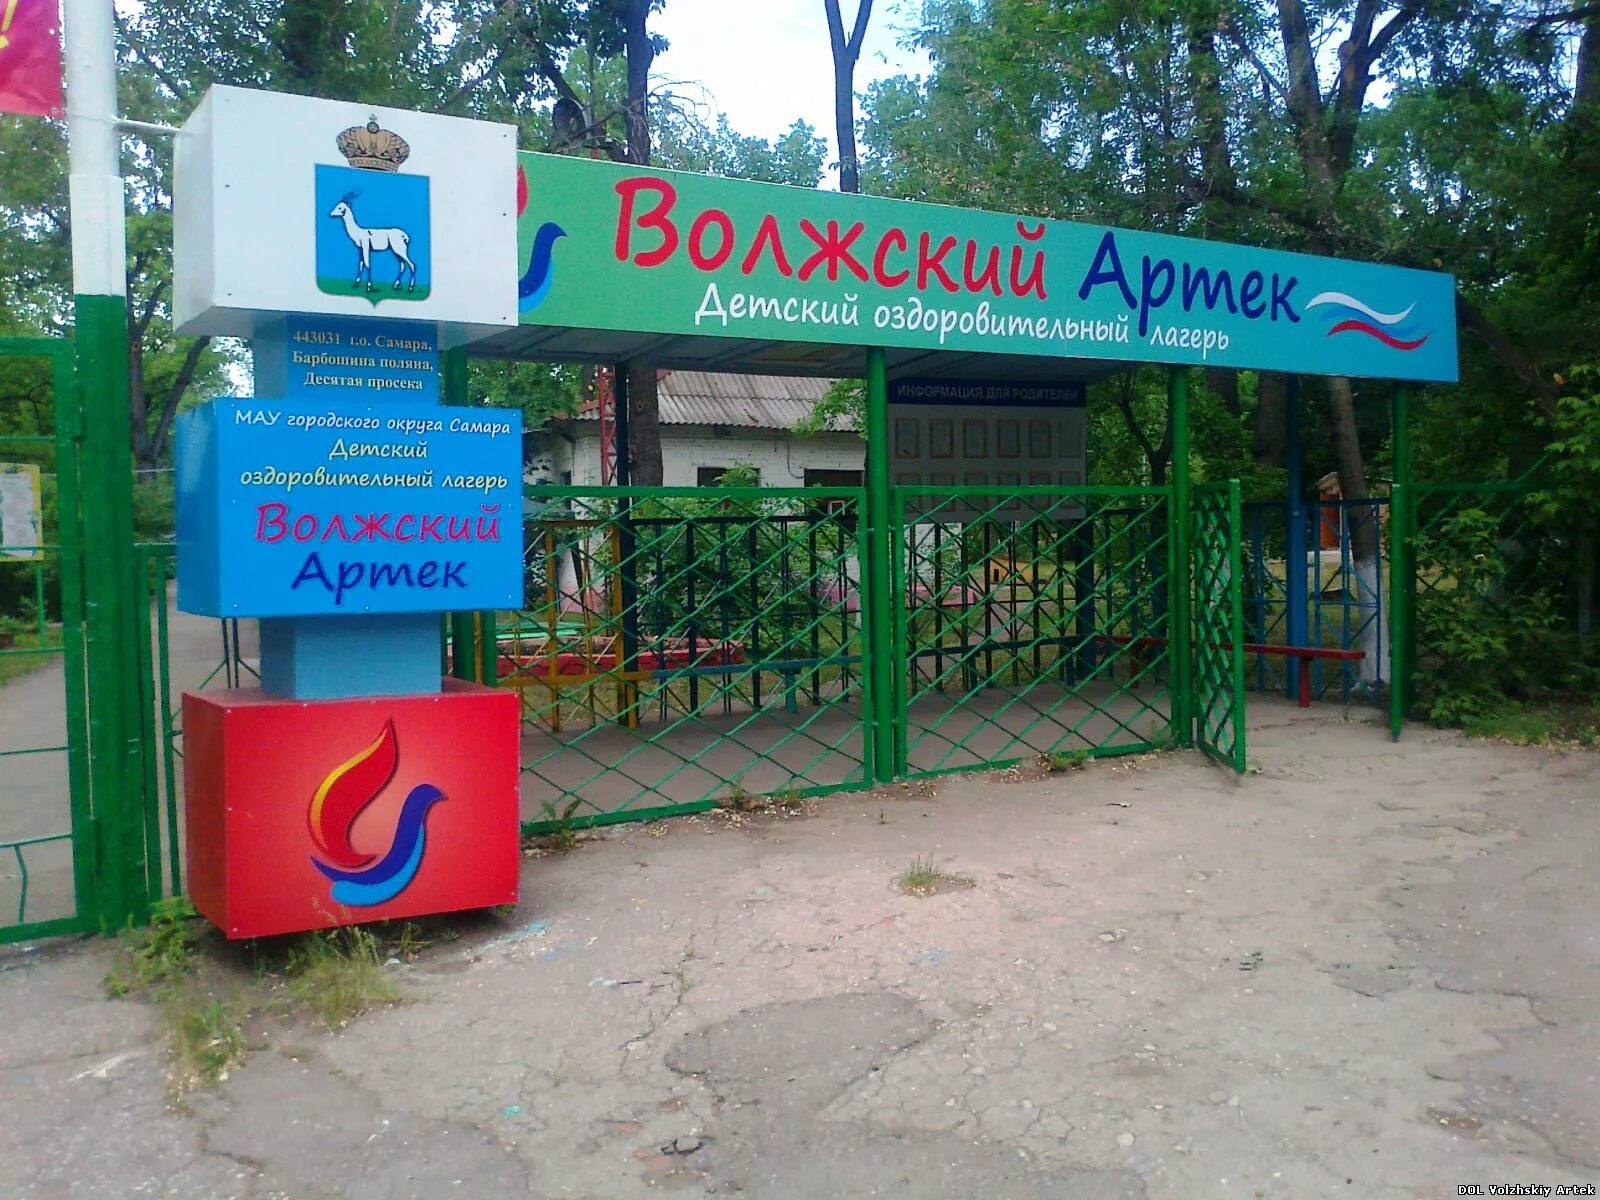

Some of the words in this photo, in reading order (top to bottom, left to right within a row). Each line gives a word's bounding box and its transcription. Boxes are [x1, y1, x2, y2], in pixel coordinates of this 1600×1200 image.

[614, 176, 1048, 300] Волжский
[1078, 230, 1300, 338] Артек
[694, 282, 860, 327] Детский
[873, 297, 1130, 345] оздоровительный
[1150, 324, 1229, 359] лагерь
[292, 329, 341, 345] 443031
[292, 350, 376, 368] Барбошина
[304, 371, 363, 387] Десятая
[367, 377, 423, 391] просека
[897, 384, 984, 400] ИНФОРМАЦИЯ
[986, 386, 1011, 400] ДЛЯ
[235, 410, 282, 426] МАУ
[287, 412, 380, 431] городского
[386, 416, 443, 436] округа
[450, 418, 511, 438] Самара
[328, 438, 428, 461] Детский
[240, 466, 433, 491] оздоровительный
[441, 475, 508, 495] лагерь
[255, 502, 501, 543] Волжский
[291, 551, 468, 605] Артек
